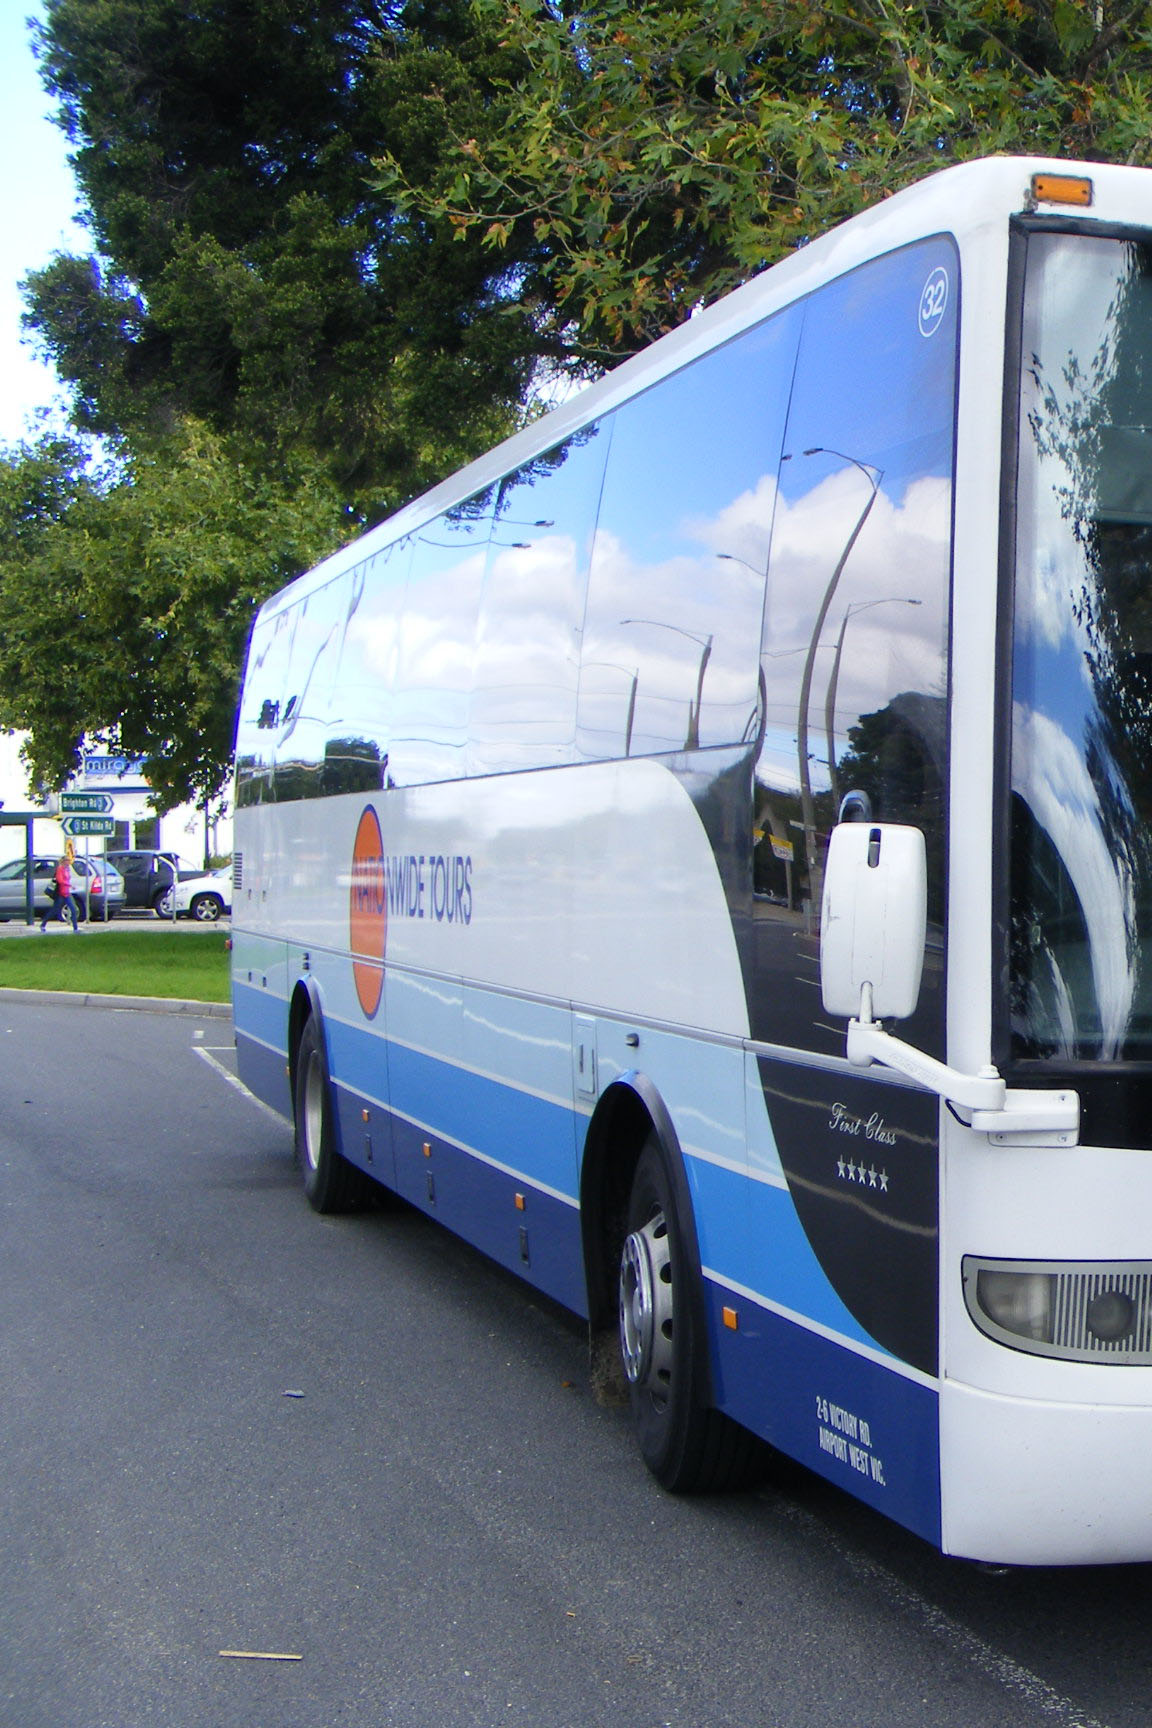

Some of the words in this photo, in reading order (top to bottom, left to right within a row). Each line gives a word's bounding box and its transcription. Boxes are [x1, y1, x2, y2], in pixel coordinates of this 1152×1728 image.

[921, 279, 945, 321] 32
[63, 797, 87, 810] Brighton
[89, 798, 97, 808] Rd
[81, 820, 88, 830] St
[90, 820, 103, 830] Kilda
[105, 820, 111, 830] Rd
[429, 855, 472, 926] TOURS
[829, 1102, 861, 1135] First
[864, 1112, 896, 1146] Class
[816, 1395, 828, 1422] 2-6
[829, 1402, 858, 1440] VICTORY
[859, 1419, 872, 1448] RD.
[819, 1426, 847, 1464] AIRPORT
[849, 1443, 869, 1476] WEST
[870, 1455, 886, 1487] VIC.
